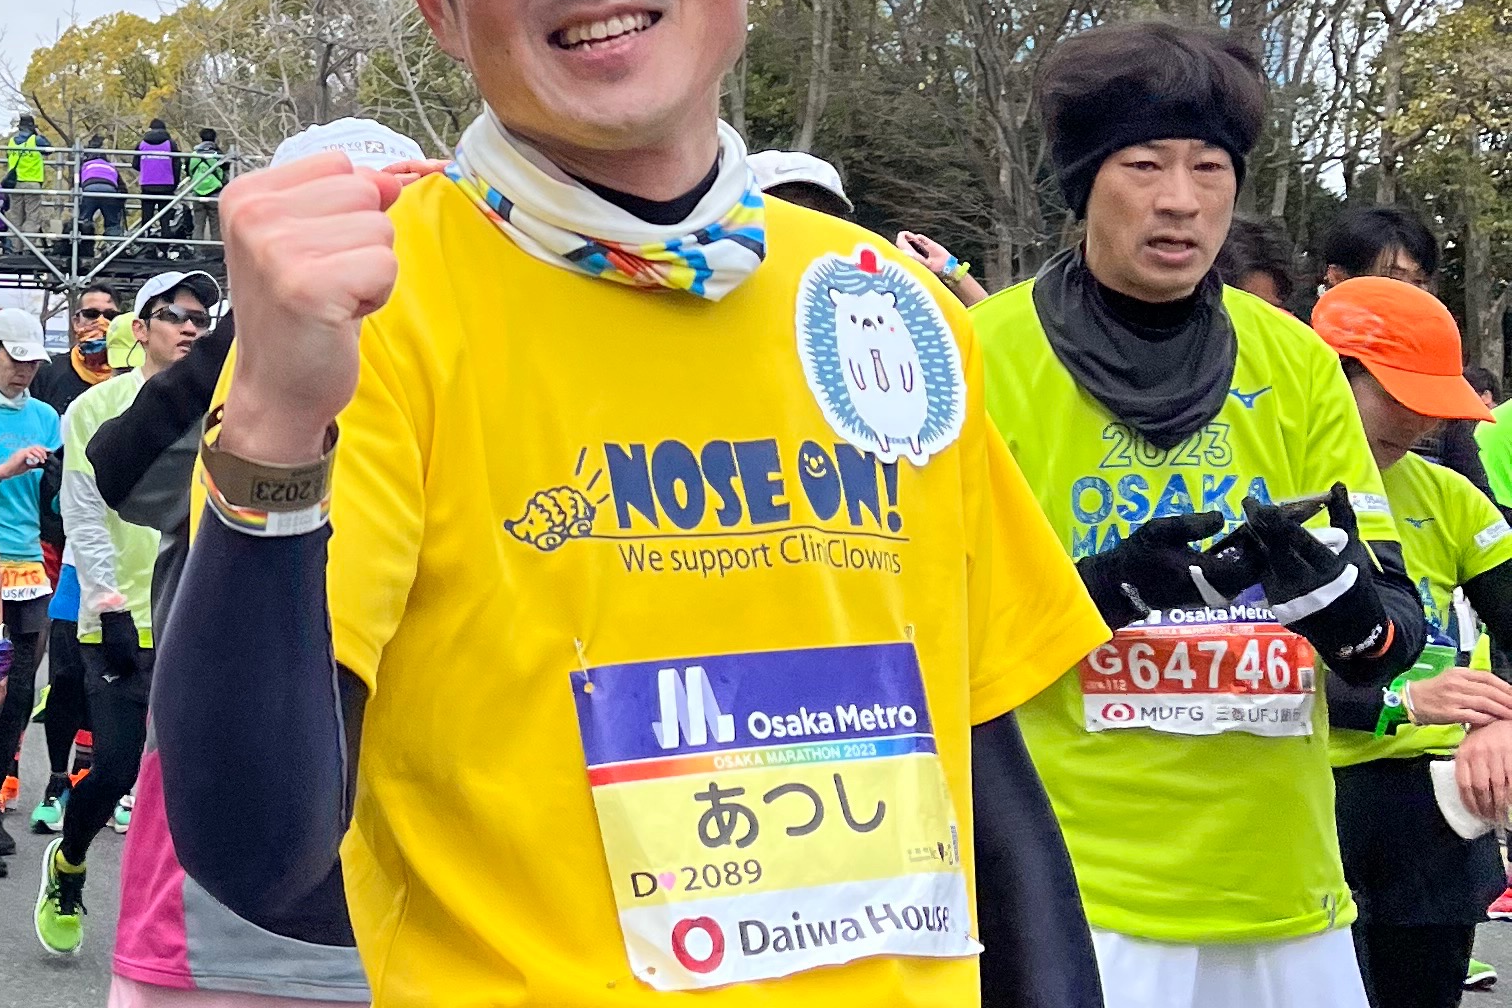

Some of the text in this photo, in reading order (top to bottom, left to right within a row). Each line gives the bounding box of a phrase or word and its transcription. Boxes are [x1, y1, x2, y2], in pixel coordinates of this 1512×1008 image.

[603, 438, 791, 530] NOSE
[1071, 473, 1273, 525] OSAKA
[618, 543, 664, 572] We
[672, 543, 770, 578] support
[1169, 607, 1229, 625] Osaka
[747, 703, 917, 739] Osaka Metro
[1140, 705, 1204, 722] MUFG
[713, 743, 877, 770] OSAKA MARATHON 2023
[693, 772, 886, 849] あつし
[680, 858, 763, 892] 2089
[737, 902, 951, 957] Daiwa House
